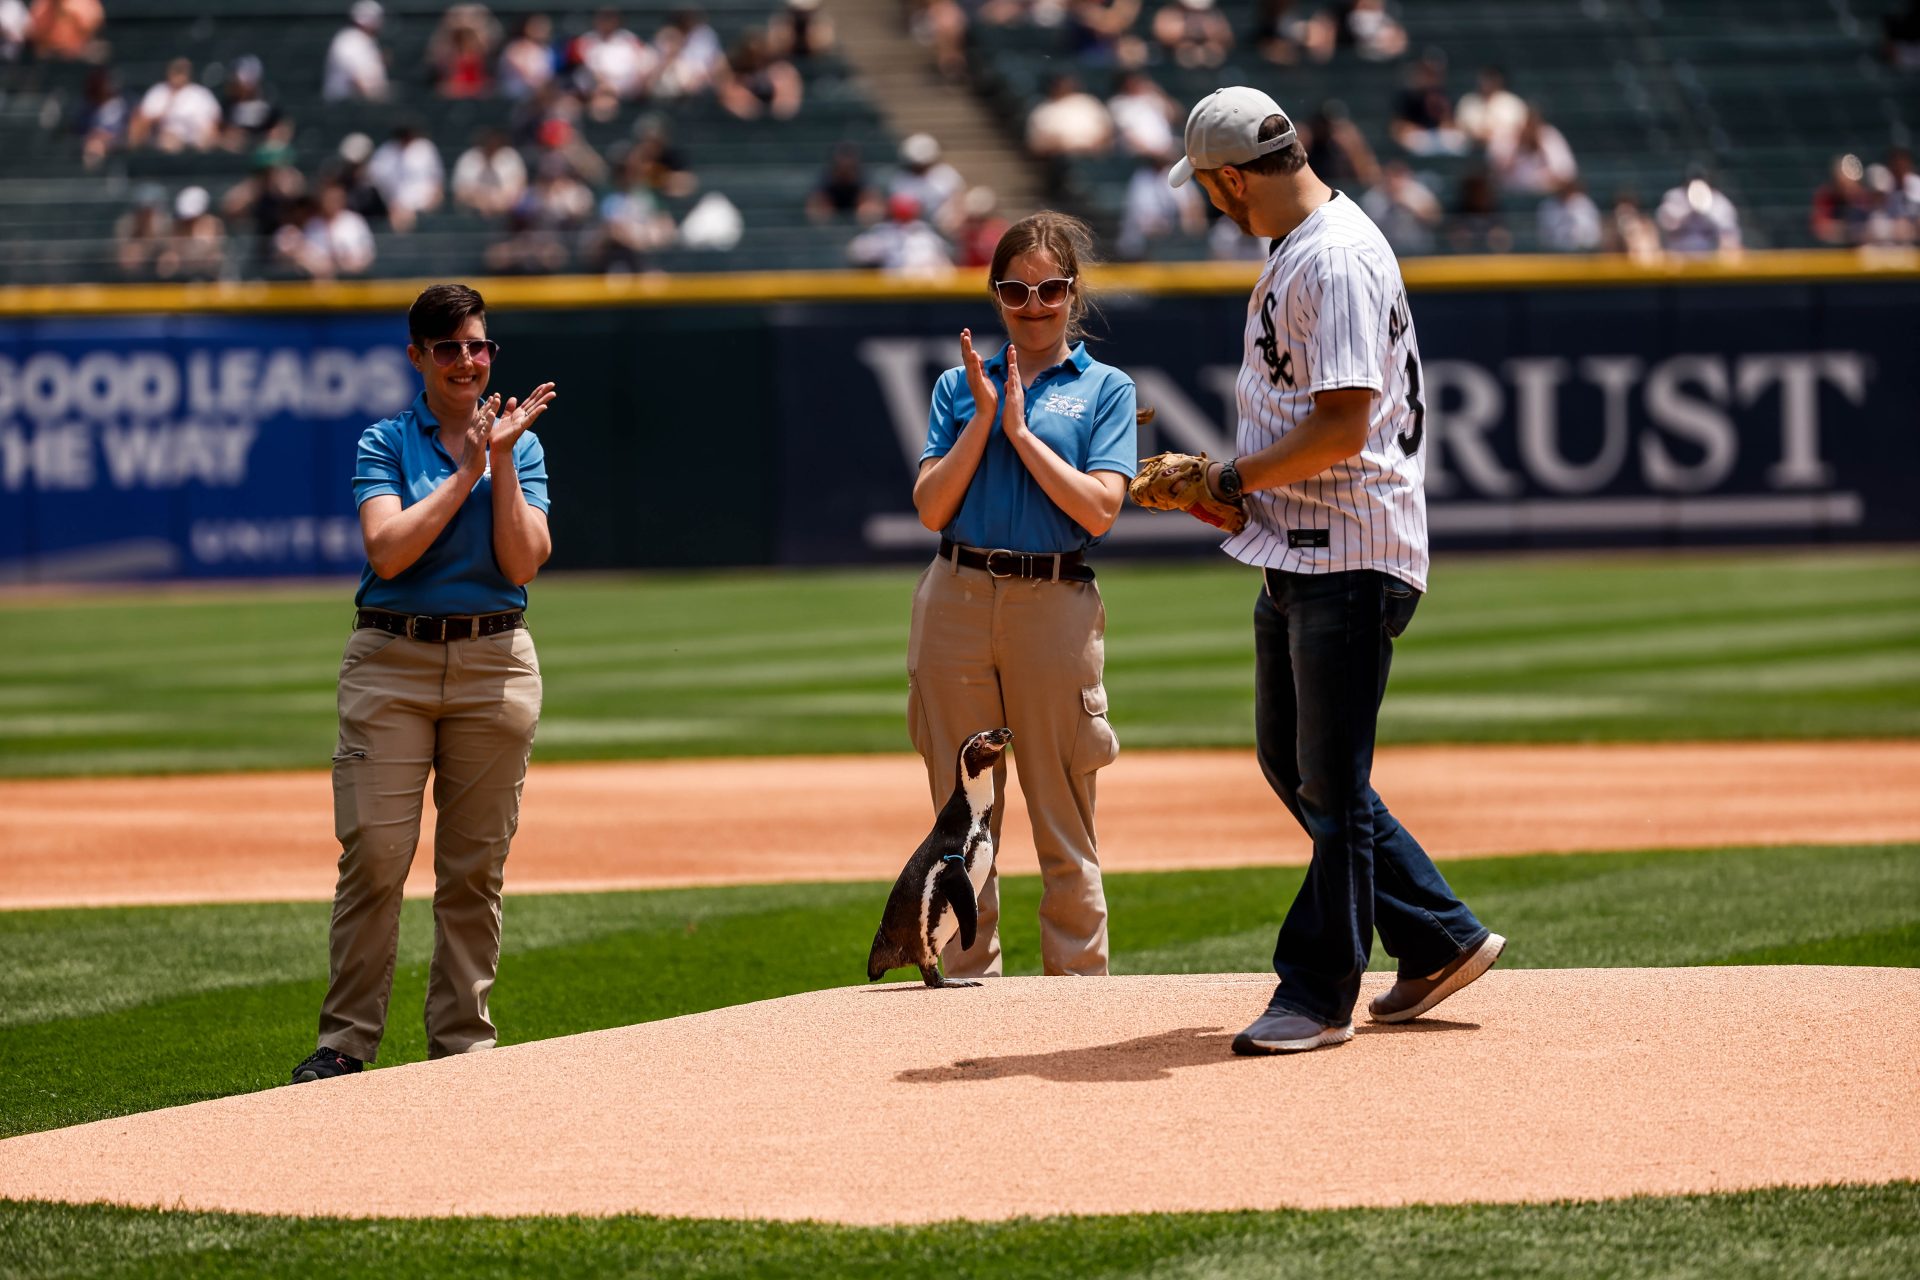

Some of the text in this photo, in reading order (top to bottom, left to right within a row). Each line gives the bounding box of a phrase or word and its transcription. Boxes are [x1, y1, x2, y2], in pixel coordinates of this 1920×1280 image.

[1255, 291, 1294, 388] Sox
[187, 346, 413, 419] LEADS
[0, 421, 256, 487] HE WAY
